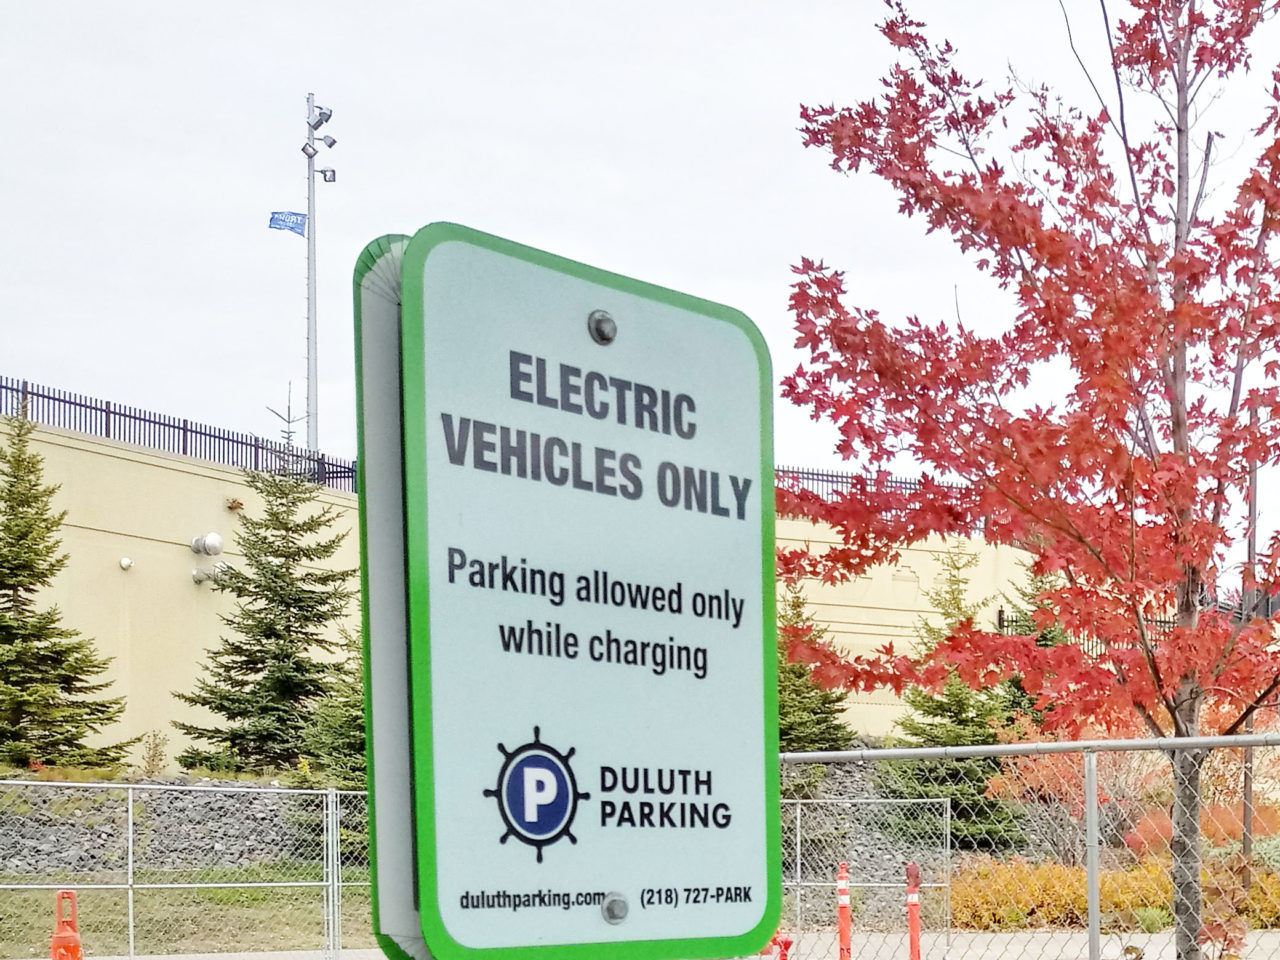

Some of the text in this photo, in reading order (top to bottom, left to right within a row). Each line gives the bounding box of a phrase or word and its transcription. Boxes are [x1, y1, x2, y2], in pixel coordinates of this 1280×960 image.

[509, 350, 697, 440] ELECTRIC
[441, 413, 752, 521] VEHICLES ONLY
[447, 547, 745, 628] Parking allowed only
[499, 619, 709, 679] while charging
[522, 766, 558, 823] P
[600, 766, 712, 795] DULUTH
[600, 801, 732, 828] PARKING
[460, 886, 752, 912] duluthparking.com (218) 727-PARK
